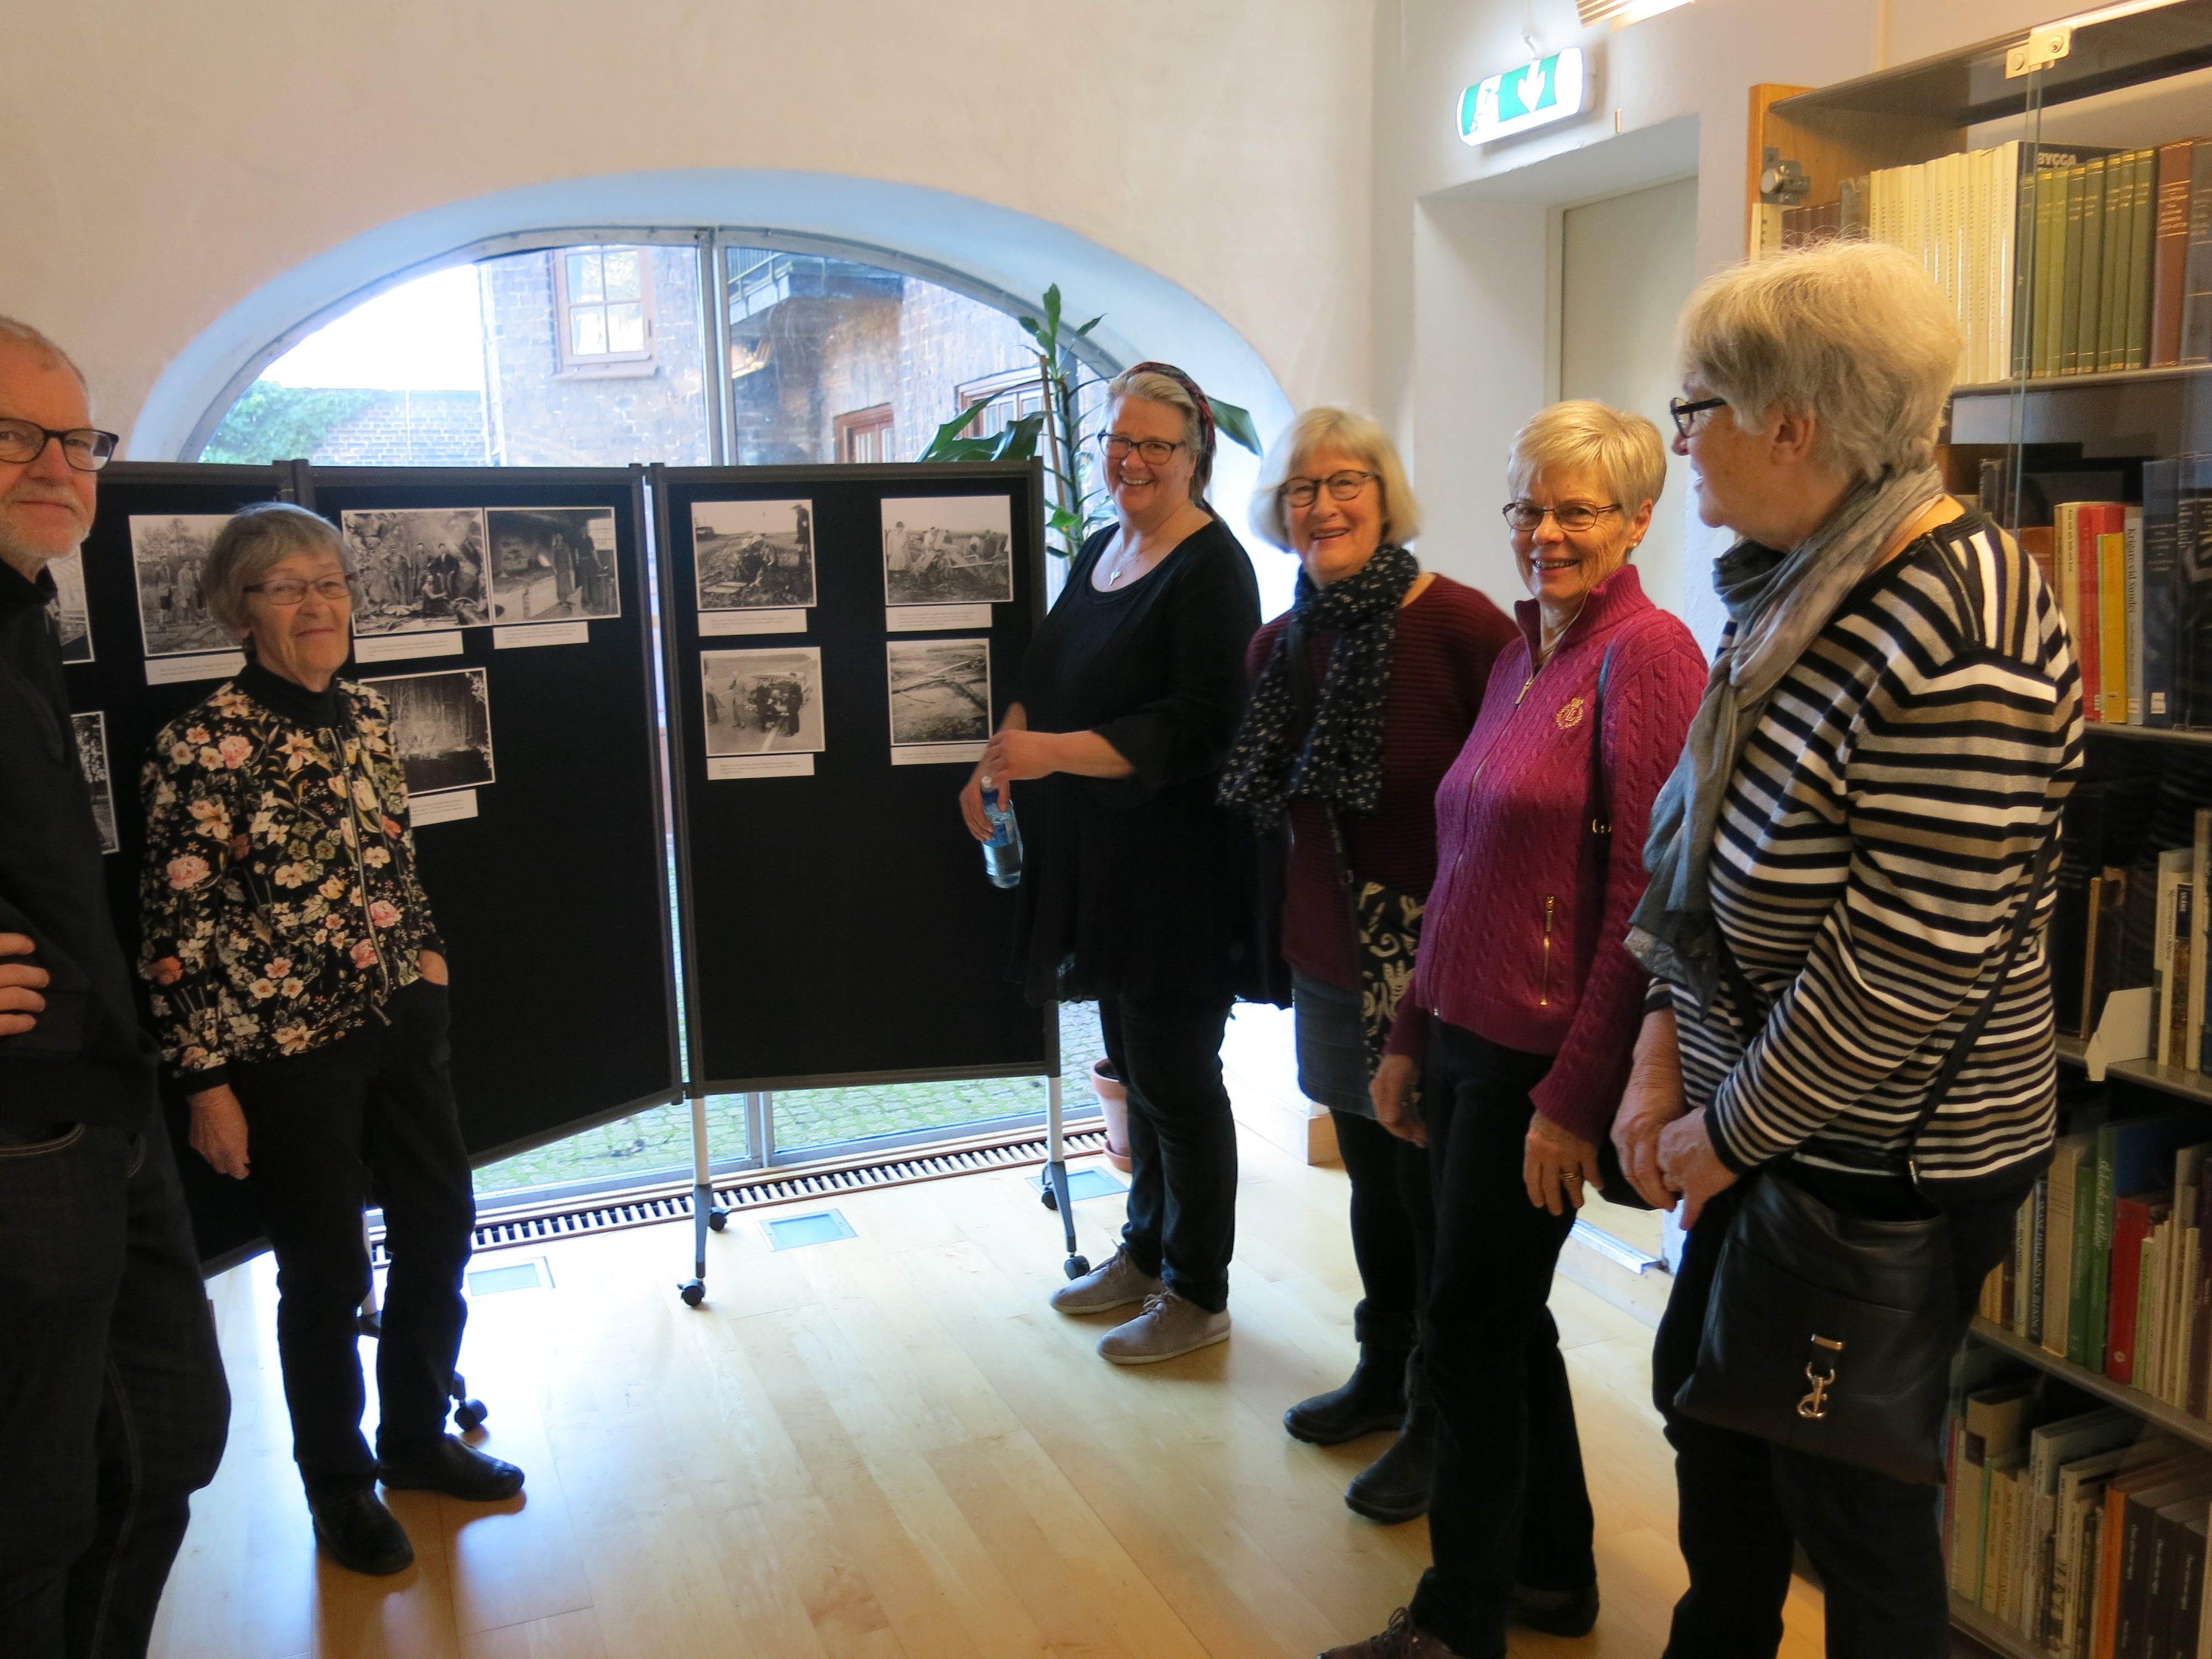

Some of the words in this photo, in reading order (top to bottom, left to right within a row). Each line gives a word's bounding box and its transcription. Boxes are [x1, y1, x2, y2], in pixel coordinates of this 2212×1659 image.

[2038, 152, 2077, 167] BYGGA
[2126, 528, 2137, 562] Krigare
[2127, 565, 2138, 580] vid
